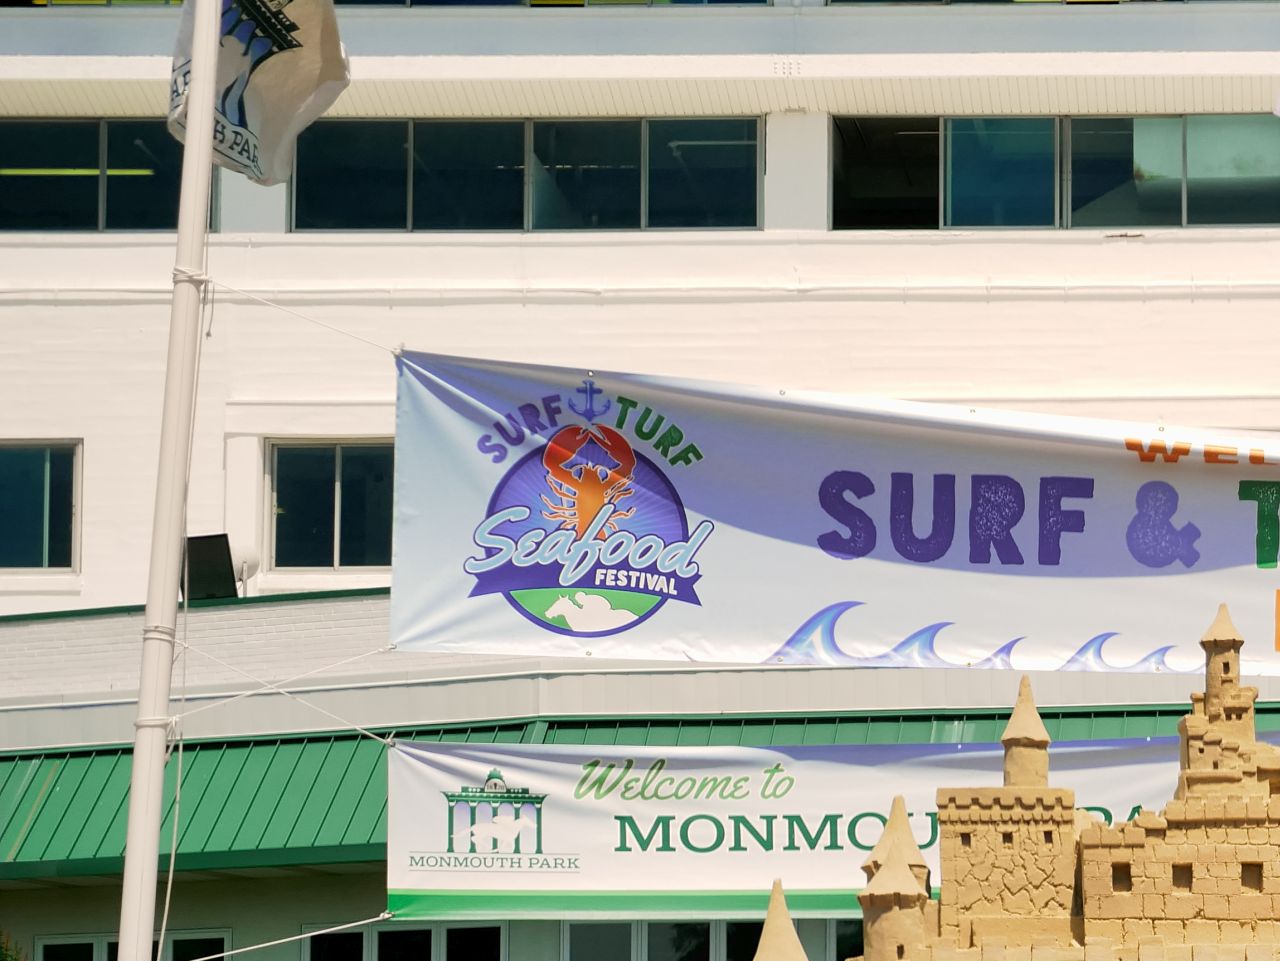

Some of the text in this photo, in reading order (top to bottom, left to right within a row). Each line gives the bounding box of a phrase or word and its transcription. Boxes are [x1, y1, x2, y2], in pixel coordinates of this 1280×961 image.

[477, 394, 704, 467] SURF TURF
[816, 470, 1094, 566] SURF
[1125, 480, 1202, 569] &
[464, 503, 714, 586] Seafood
[595, 568, 678, 595] FESTIVAL
[573, 758, 796, 801] Welcome to
[614, 812, 938, 853] MONMOU
[409, 856, 580, 869] MONMOUTH PARK
